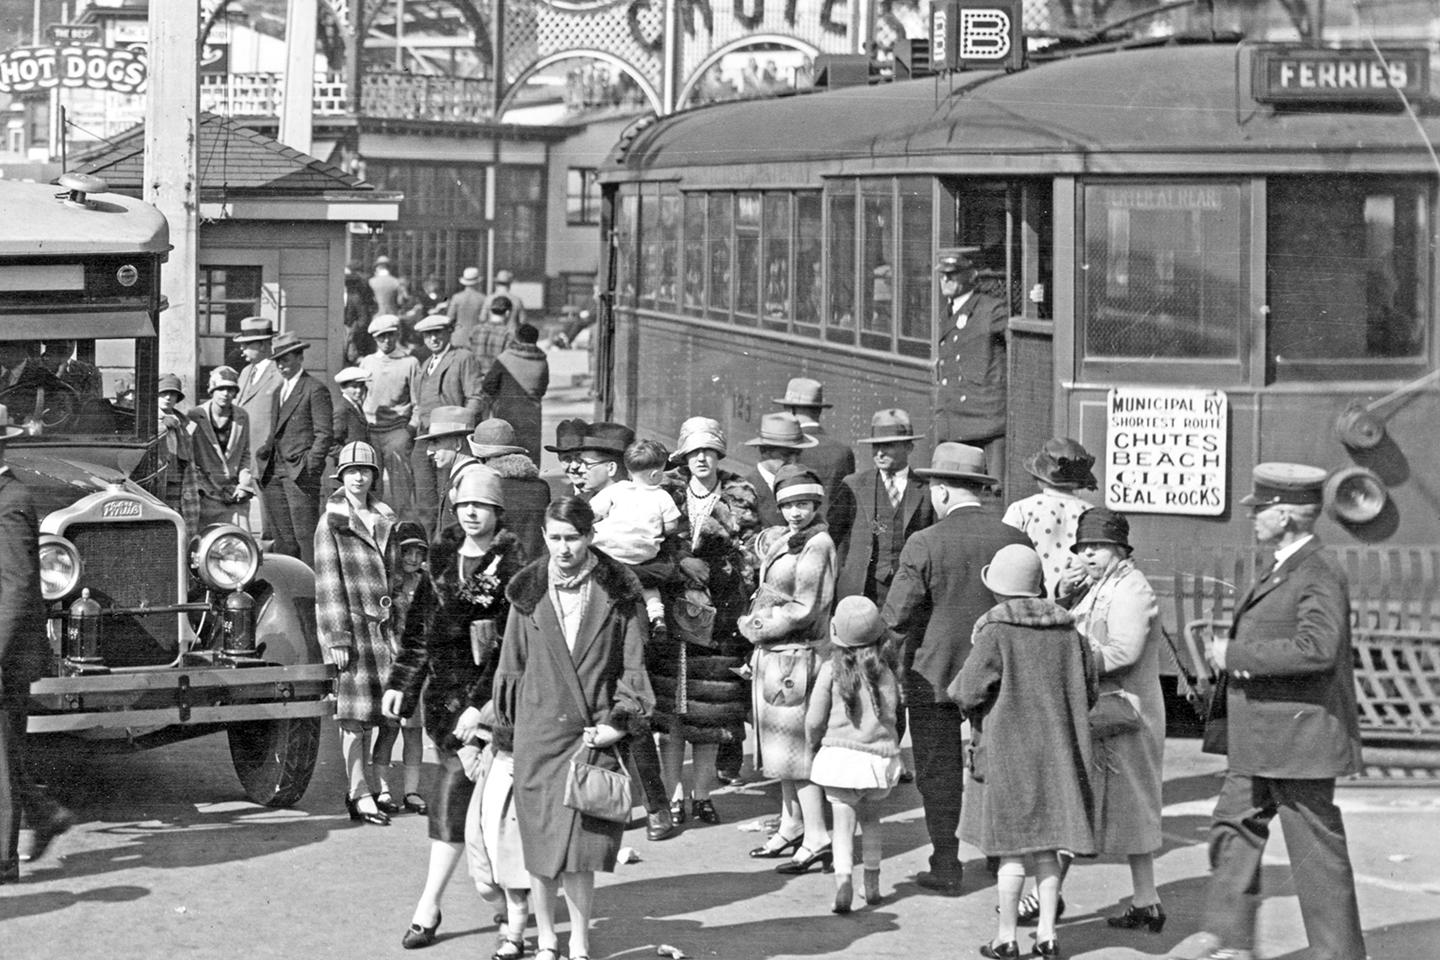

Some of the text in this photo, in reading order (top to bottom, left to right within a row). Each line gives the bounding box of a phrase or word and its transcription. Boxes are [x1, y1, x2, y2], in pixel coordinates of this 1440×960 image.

[71, 28, 94, 39] BEST
[960, 8, 1011, 59] B
[0, 56, 145, 85] HOT DOGS
[1281, 61, 1408, 89] FERRIES
[1112, 397, 1196, 414] MUNICIPAL
[1112, 416, 1221, 429] SHORTEST ROUTE
[1114, 432, 1218, 453] CHUTES
[1112, 451, 1220, 468] BEACH
[1116, 470, 1217, 486] CLIFF
[1110, 483, 1221, 507] SEAL ROCKS
